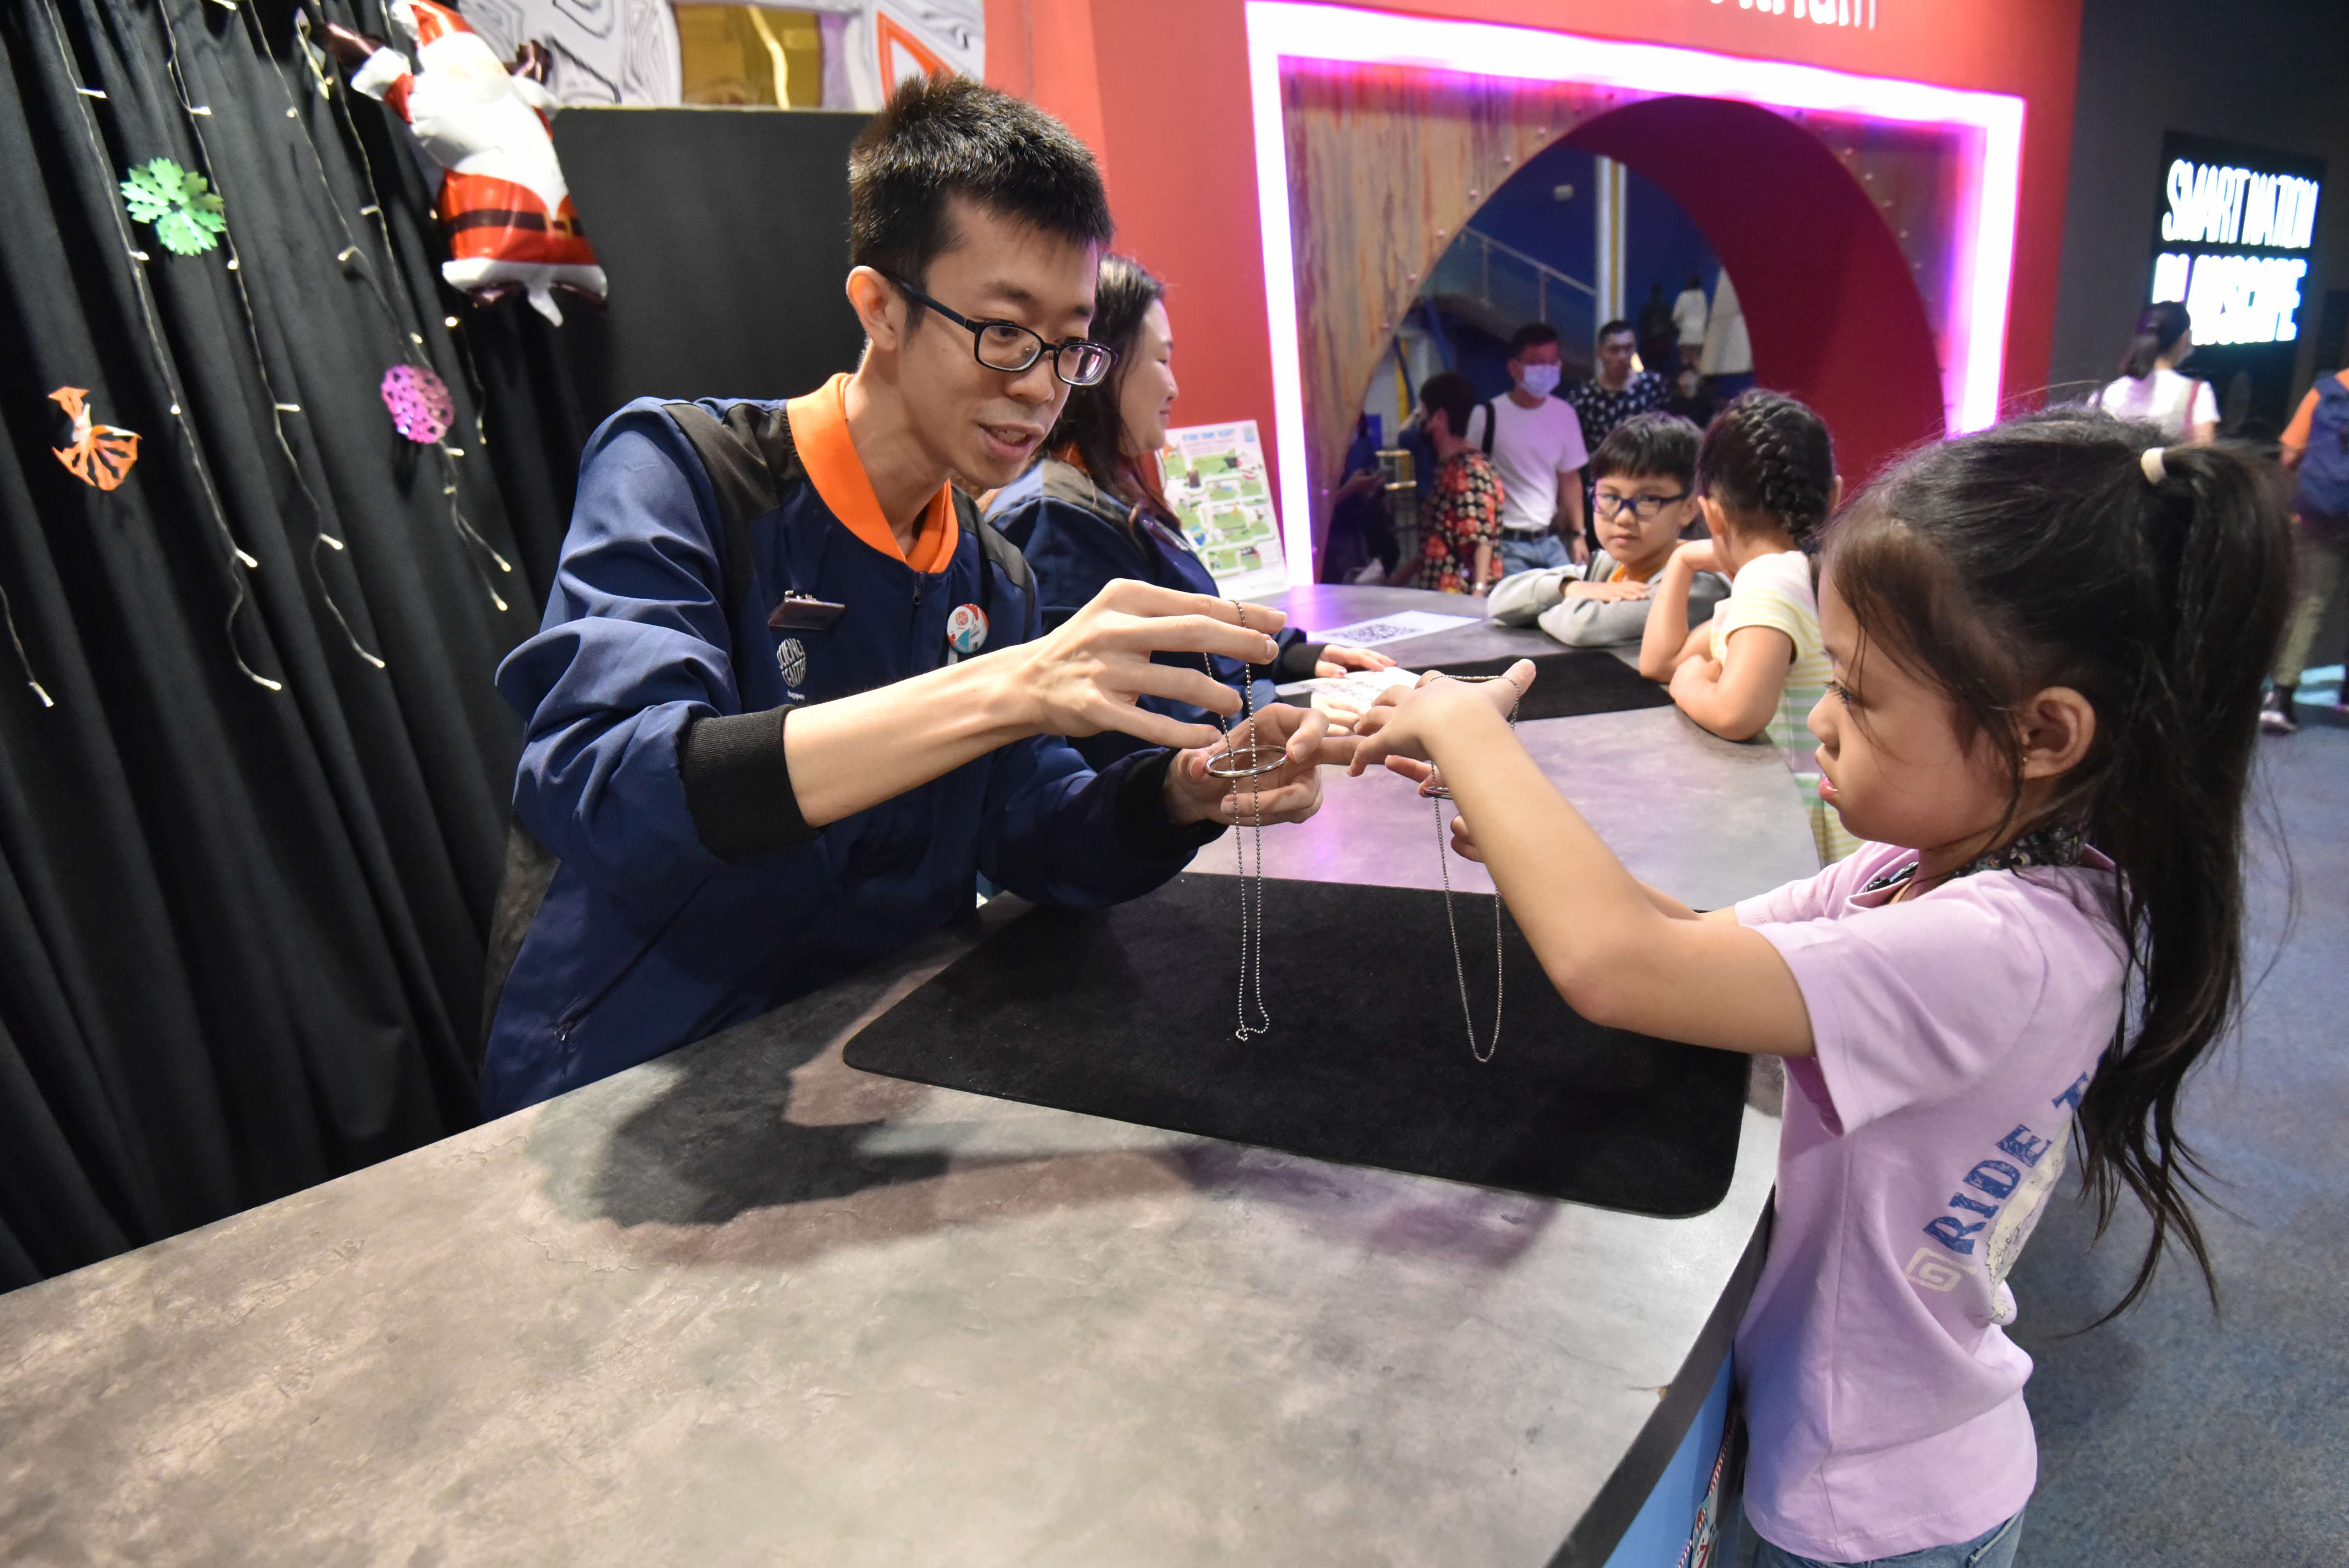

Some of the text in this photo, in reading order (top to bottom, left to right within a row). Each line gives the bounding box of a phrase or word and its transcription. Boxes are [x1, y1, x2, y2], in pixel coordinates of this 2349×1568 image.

[2162, 159, 2320, 249] SMART NATION
[1923, 1123, 2052, 1255] RIDE
